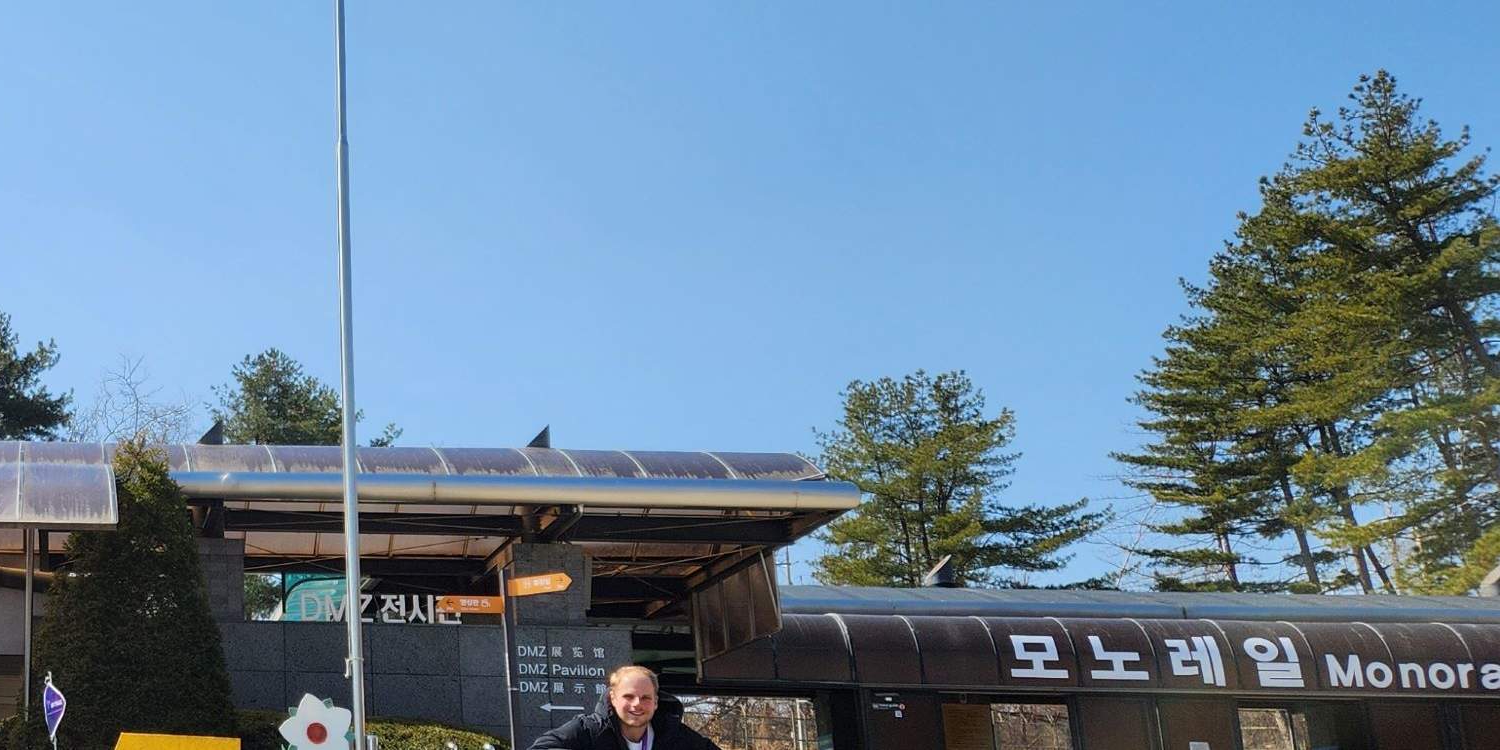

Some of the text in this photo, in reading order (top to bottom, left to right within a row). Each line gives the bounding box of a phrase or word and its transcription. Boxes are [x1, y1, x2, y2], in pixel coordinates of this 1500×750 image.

[518, 646, 547, 657] DMZ
[519, 664, 605, 677] DMZ Pavilion
[1325, 654, 1500, 688] Monora
[520, 682, 549, 694] DMZ
